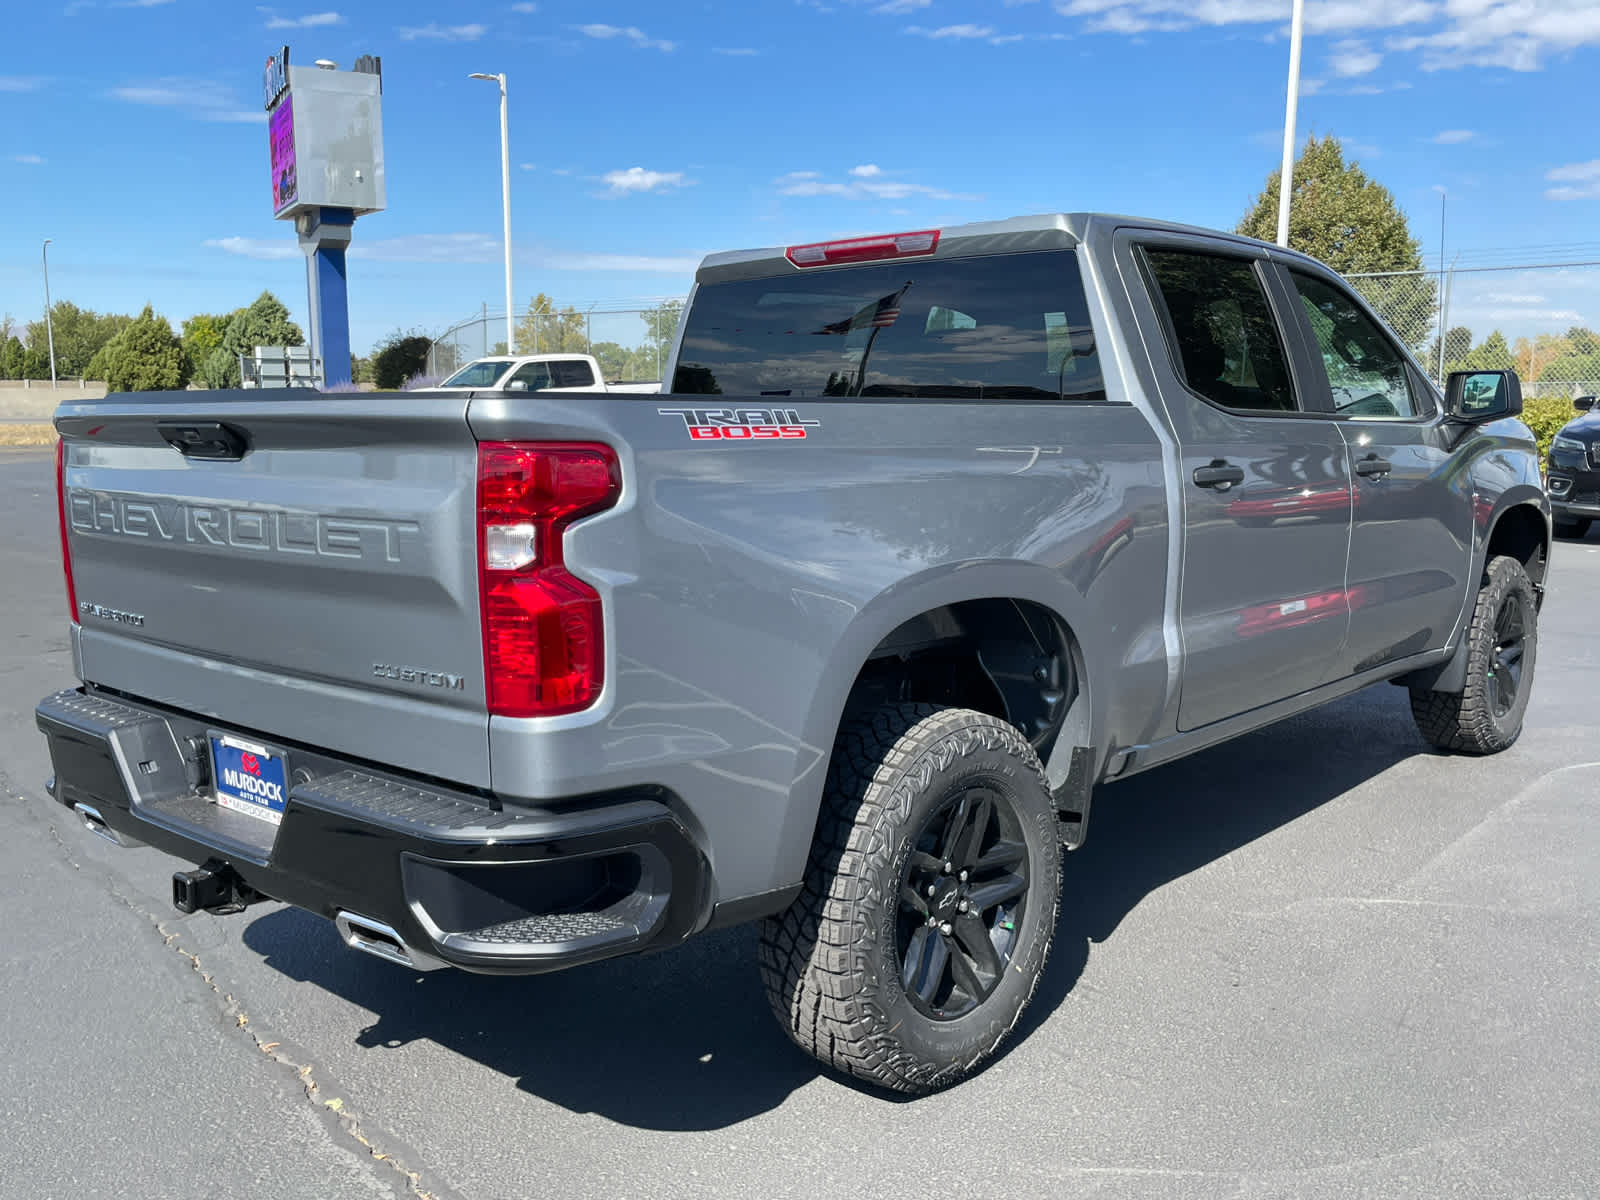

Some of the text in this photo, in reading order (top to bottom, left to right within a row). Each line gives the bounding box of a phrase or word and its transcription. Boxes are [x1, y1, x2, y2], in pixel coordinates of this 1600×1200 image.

[657, 408, 821, 427] TRAIL
[688, 425, 807, 440] BOSS
[70, 495, 419, 562] CHEVROLET
[372, 663, 464, 690] CUSTOM
[225, 768, 283, 802] MURDOCK
